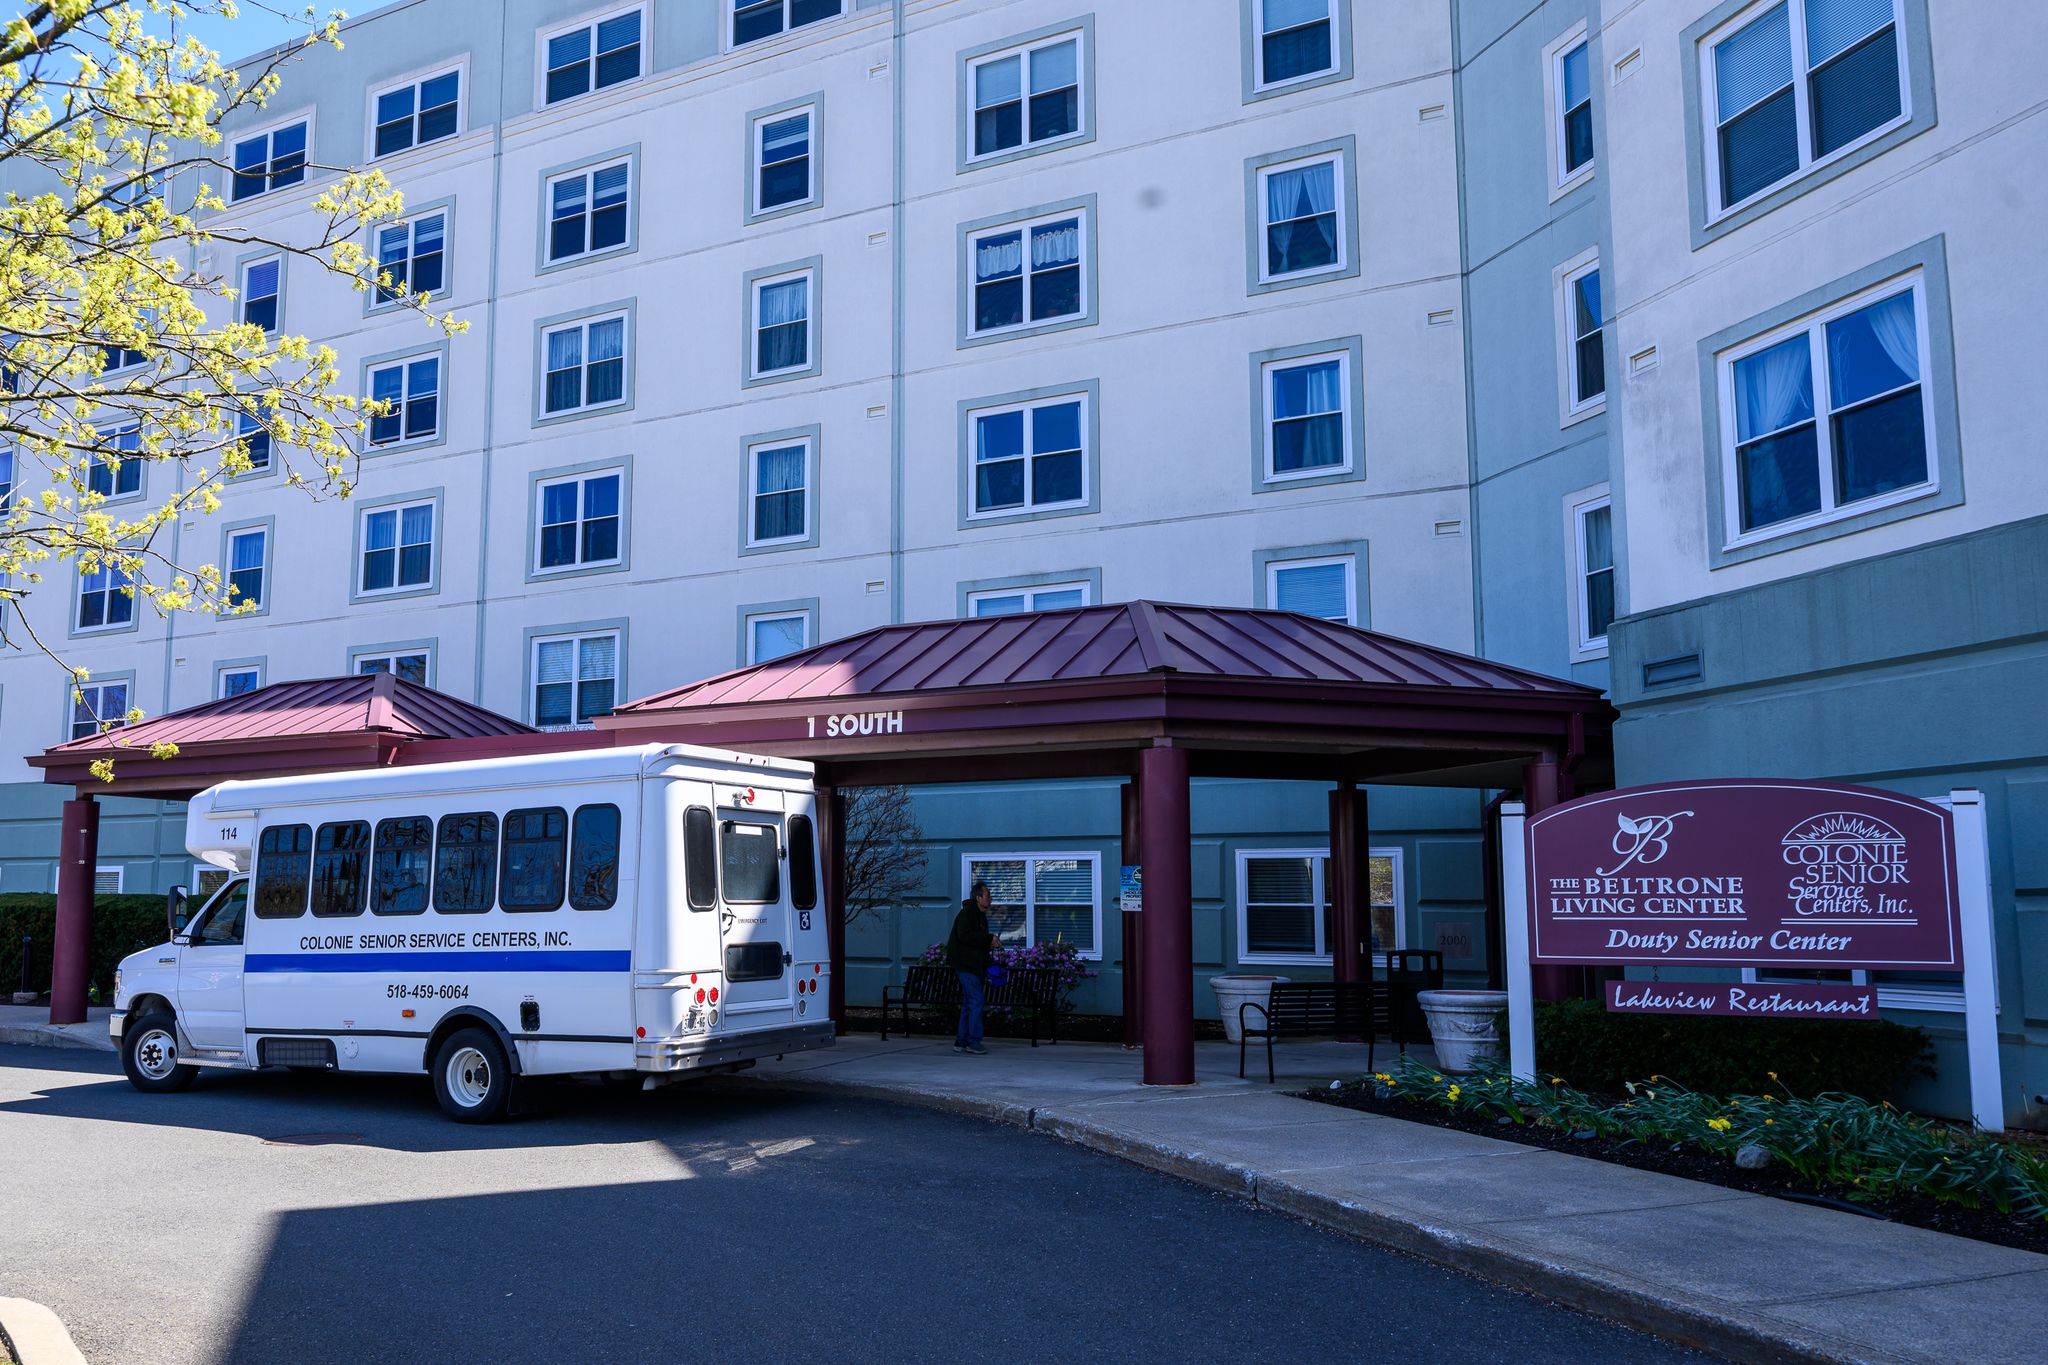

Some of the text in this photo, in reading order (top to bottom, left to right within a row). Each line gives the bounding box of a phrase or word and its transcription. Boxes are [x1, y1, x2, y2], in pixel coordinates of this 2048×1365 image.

[807, 711, 903, 738] 1 SOUTH
[221, 827, 237, 840] 114
[1783, 844, 1908, 865] COLONIE
[1806, 864, 1910, 884] SENIOR
[1550, 877, 1744, 895] THE BELTRONE
[1787, 876, 1865, 900] Service
[1551, 898, 1746, 914] LIVING CENTER
[1795, 893, 1913, 915] Centers, Inc.
[300, 931, 572, 950] COLONIE SENIOR SERVICE CENTERS, INC.
[1440, 935, 1466, 945] 2000
[1605, 929, 1851, 953] Douty Senior Center
[386, 984, 469, 999] 518-459-6064
[1615, 985, 1870, 1014] Lakeview Restaurant
